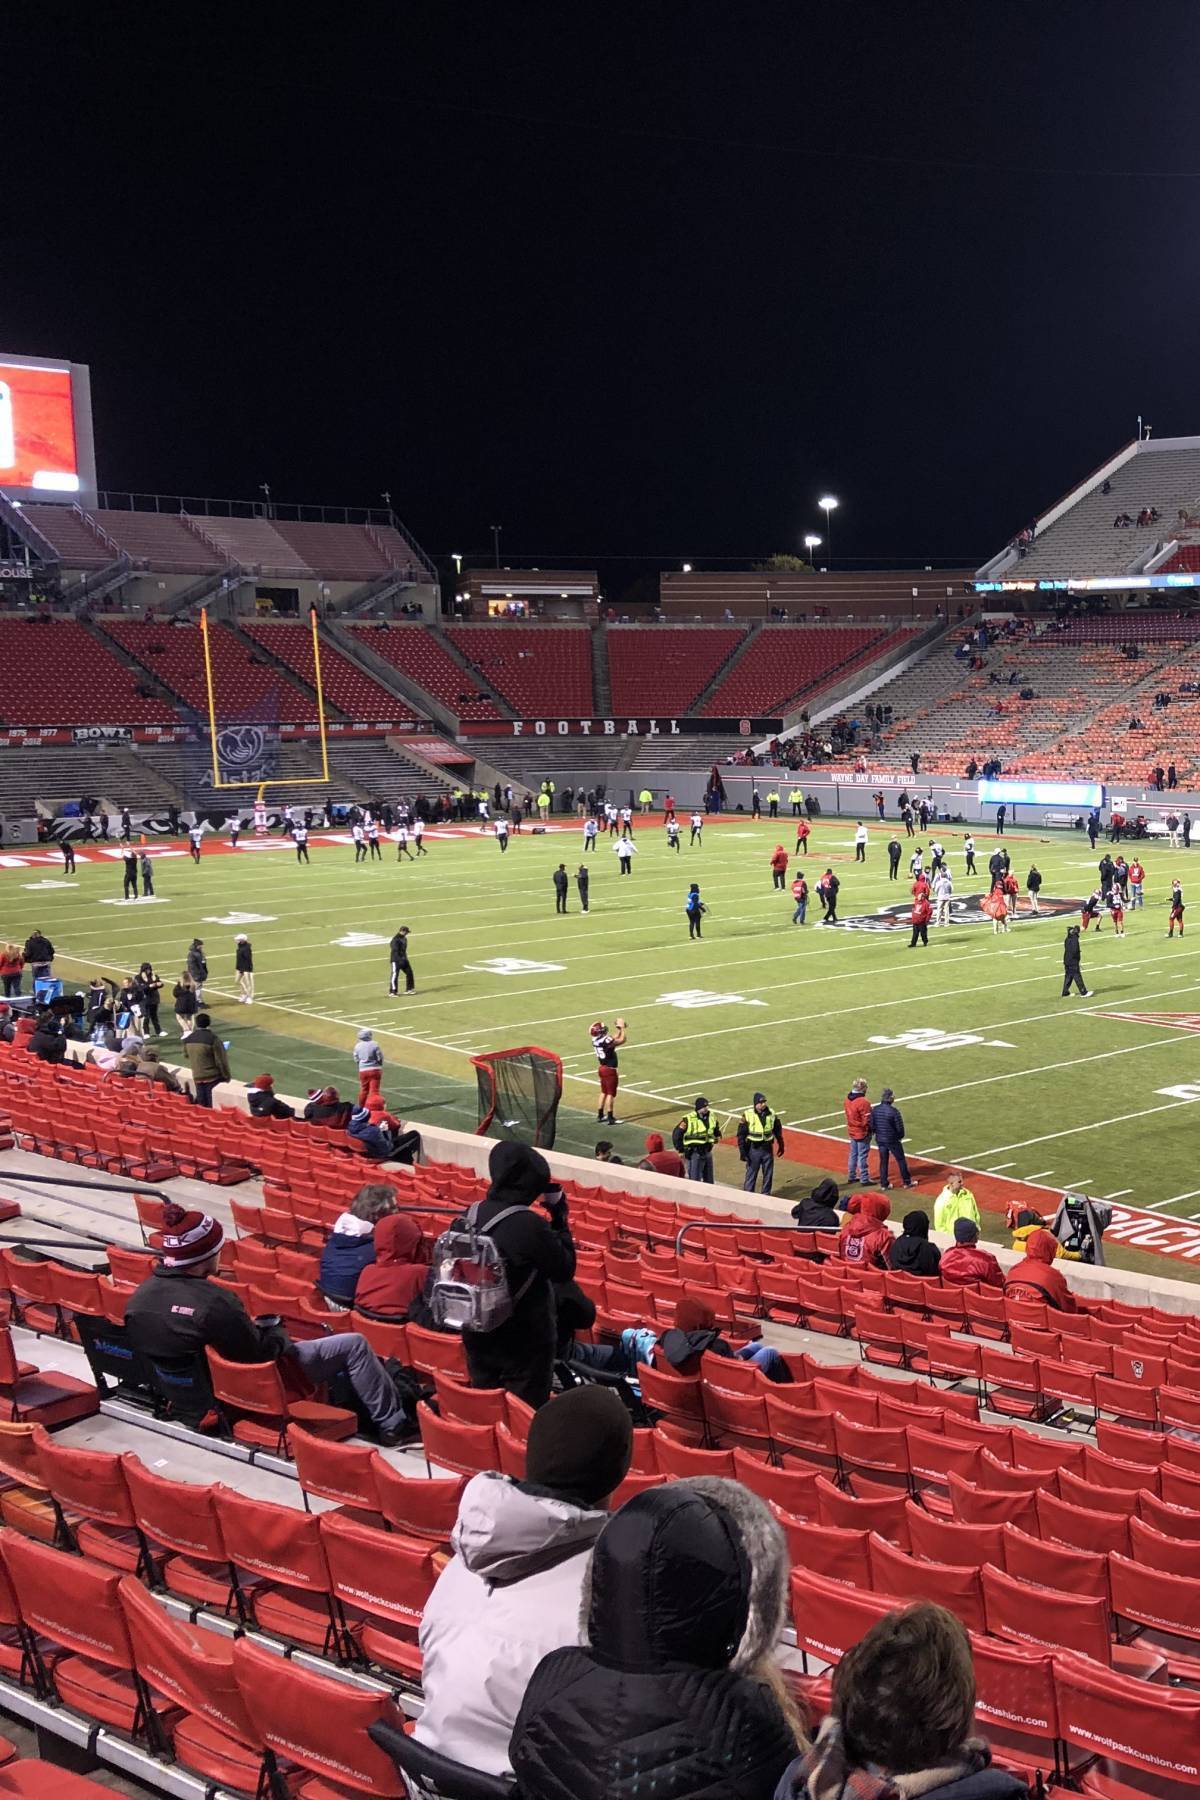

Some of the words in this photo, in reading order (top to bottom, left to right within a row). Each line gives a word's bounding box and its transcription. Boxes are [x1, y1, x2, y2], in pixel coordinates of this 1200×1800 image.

[75, 727, 131, 740] BOWL
[513, 721, 680, 735] FOOTBALL
[831, 773, 853, 783] WAYNE
[856, 774, 868, 783] DAY
[871, 775, 894, 784] FAMILY
[897, 776, 915, 785] FIELD
[867, 1028, 984, 1051] 30
[265, 1731, 374, 1785] www.wolfpackcushion.com
[1069, 1723, 1199, 1776] www.wolfpackcushion.com
